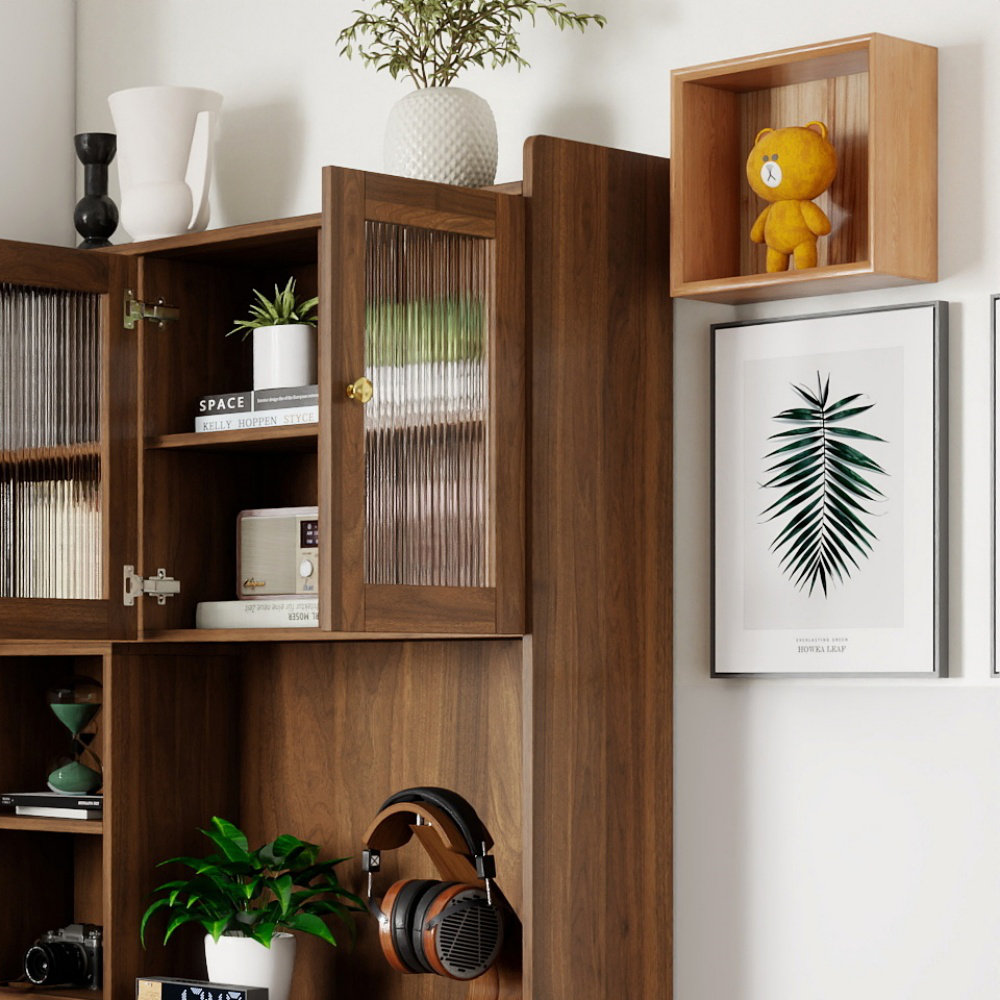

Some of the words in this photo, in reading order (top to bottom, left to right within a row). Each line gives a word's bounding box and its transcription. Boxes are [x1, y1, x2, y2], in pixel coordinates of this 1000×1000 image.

[199, 396, 244, 412] SPACE
[202, 420, 232, 432] KELLY
[238, 416, 277, 428] HOPPEN
[288, 612, 308, 620] MOSER
